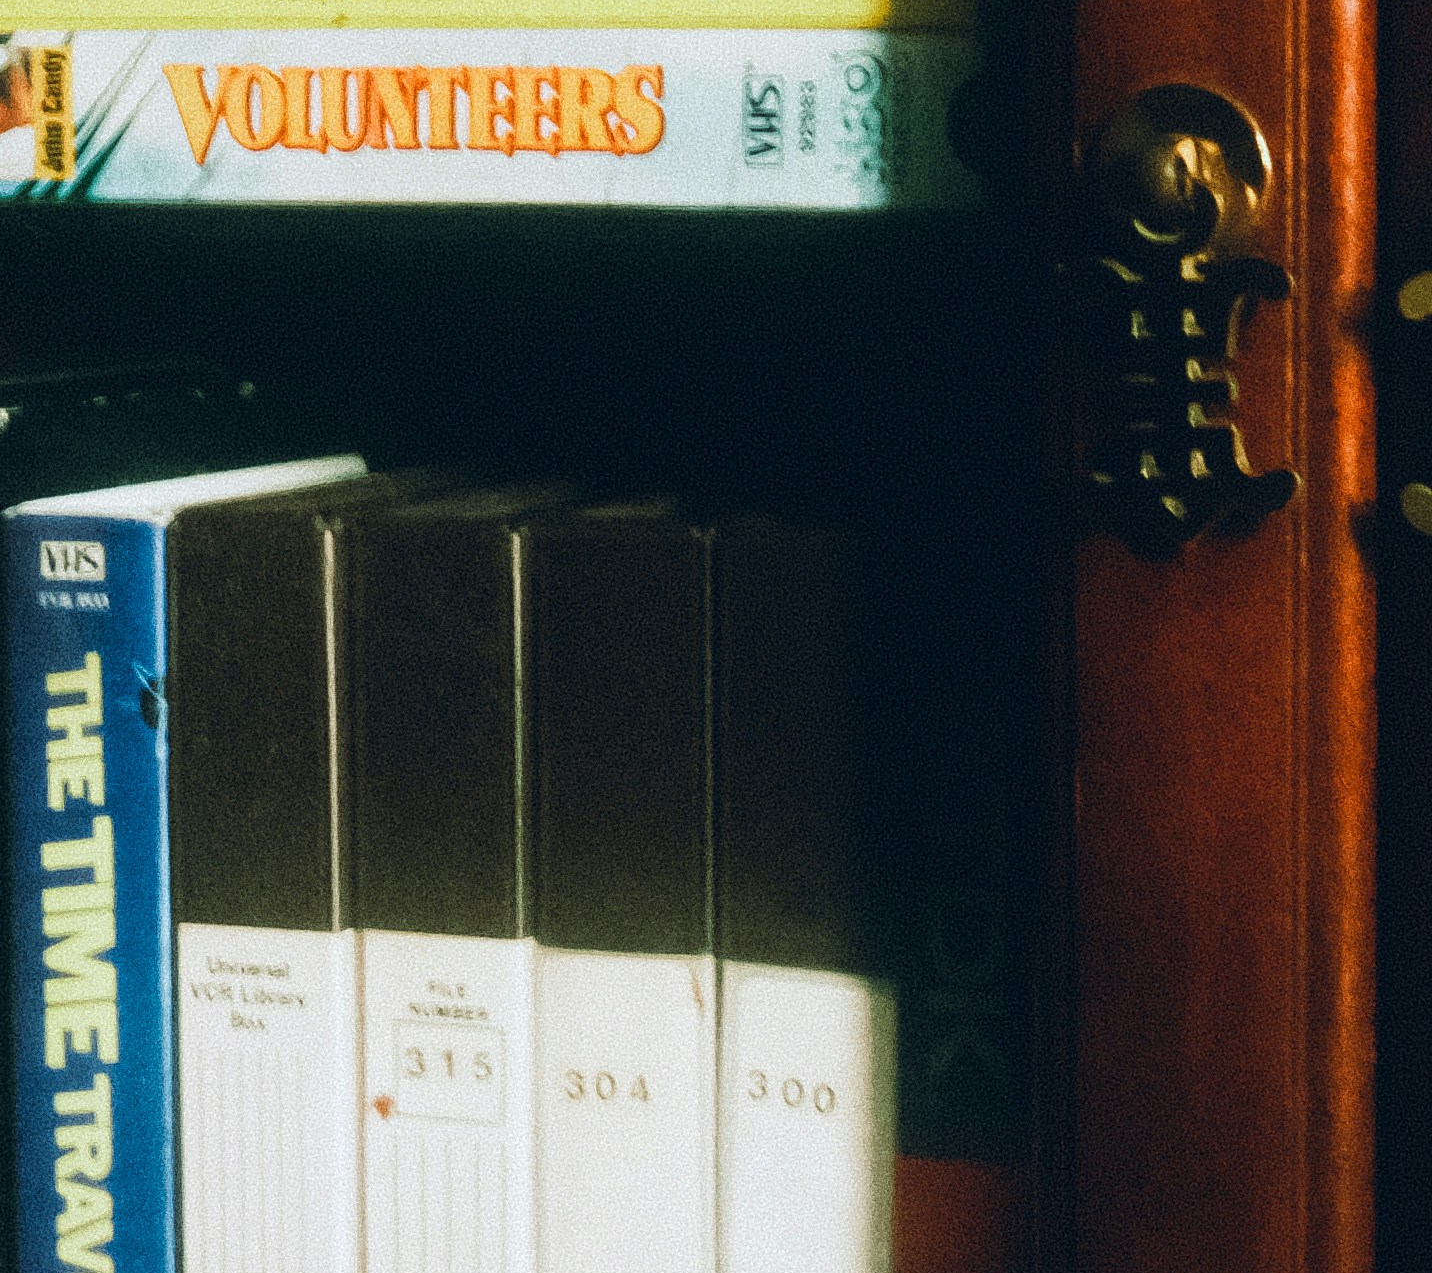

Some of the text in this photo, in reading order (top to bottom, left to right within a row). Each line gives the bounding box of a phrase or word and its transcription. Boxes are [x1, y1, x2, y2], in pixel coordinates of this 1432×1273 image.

[40, 49, 66, 115] Candy
[162, 63, 665, 167] VOLUNTEERS
[748, 77, 782, 157] VHS
[44, 652, 105, 813] THE
[40, 814, 120, 1071] TIME
[404, 1045, 494, 1084] 315
[563, 1067, 652, 1104] 304
[747, 1068, 837, 1115] 300
